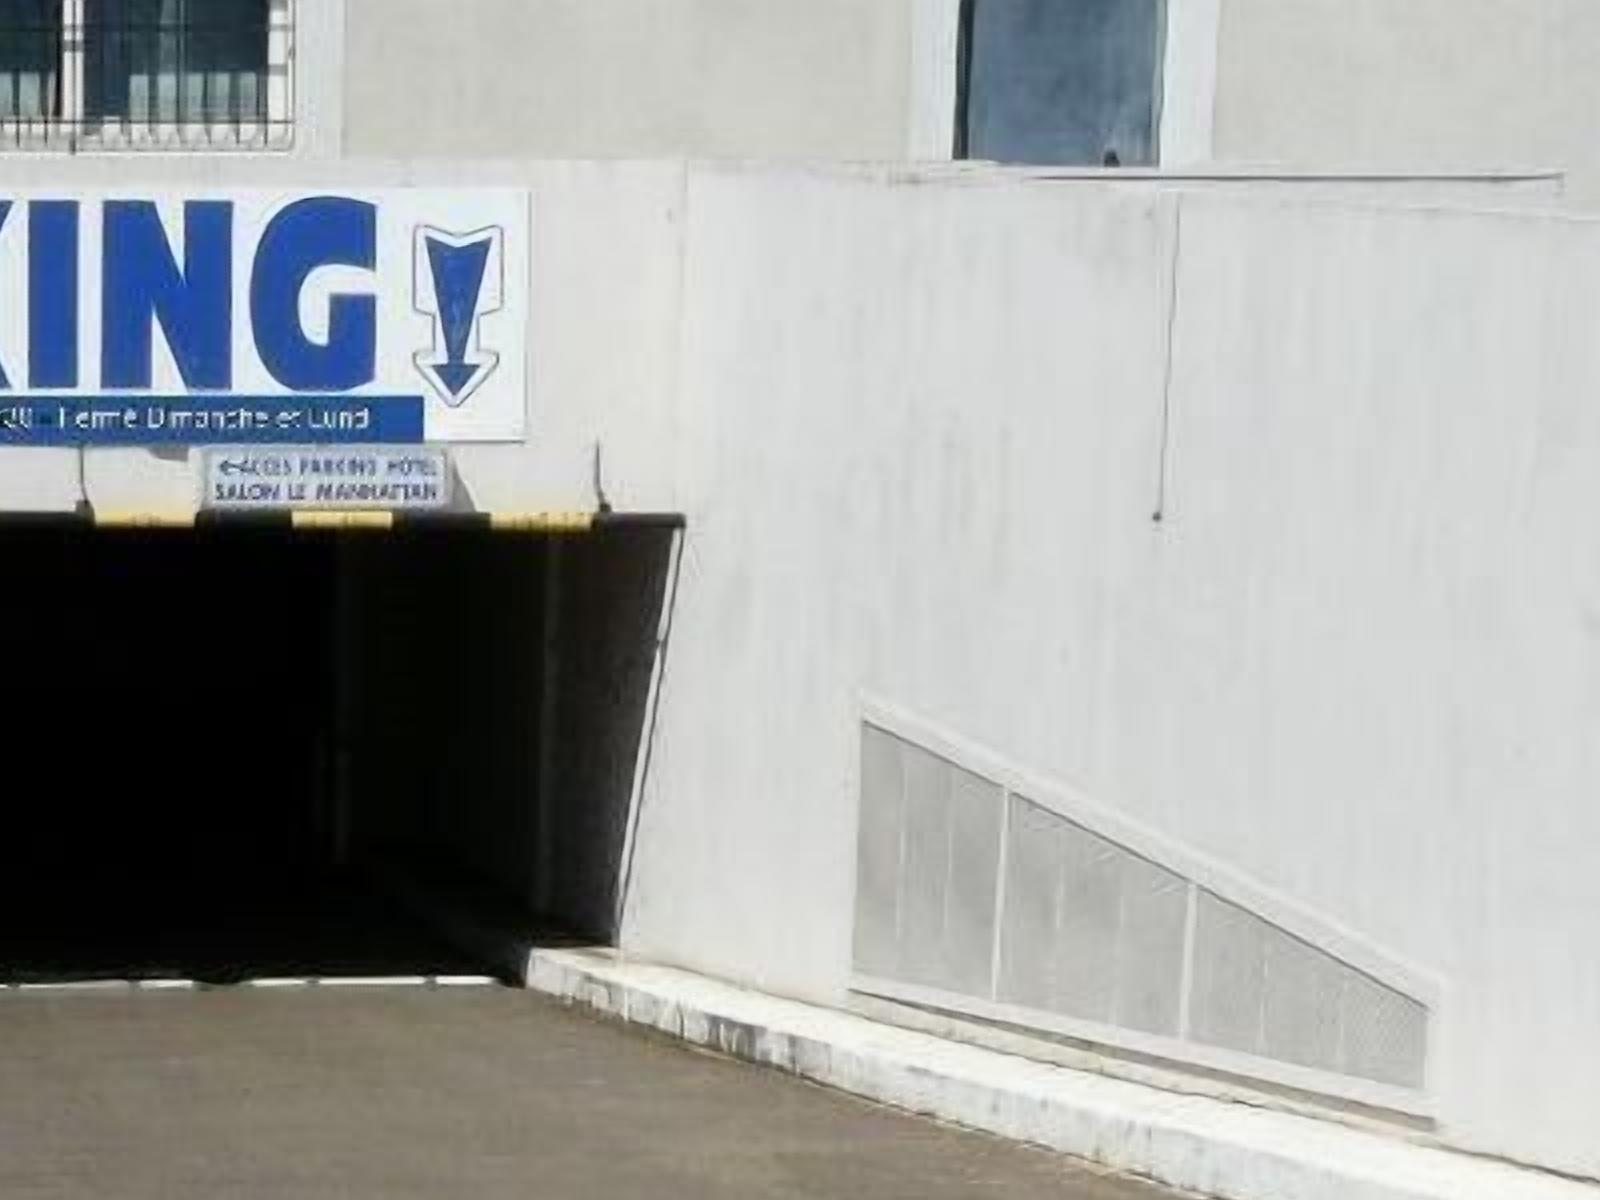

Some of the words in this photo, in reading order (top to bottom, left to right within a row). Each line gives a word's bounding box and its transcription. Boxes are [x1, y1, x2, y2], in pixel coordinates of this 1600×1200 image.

[146, 406, 270, 430] Dmanche
[307, 406, 374, 430] Lund
[214, 483, 281, 501] SALON
[288, 483, 306, 501] LE
